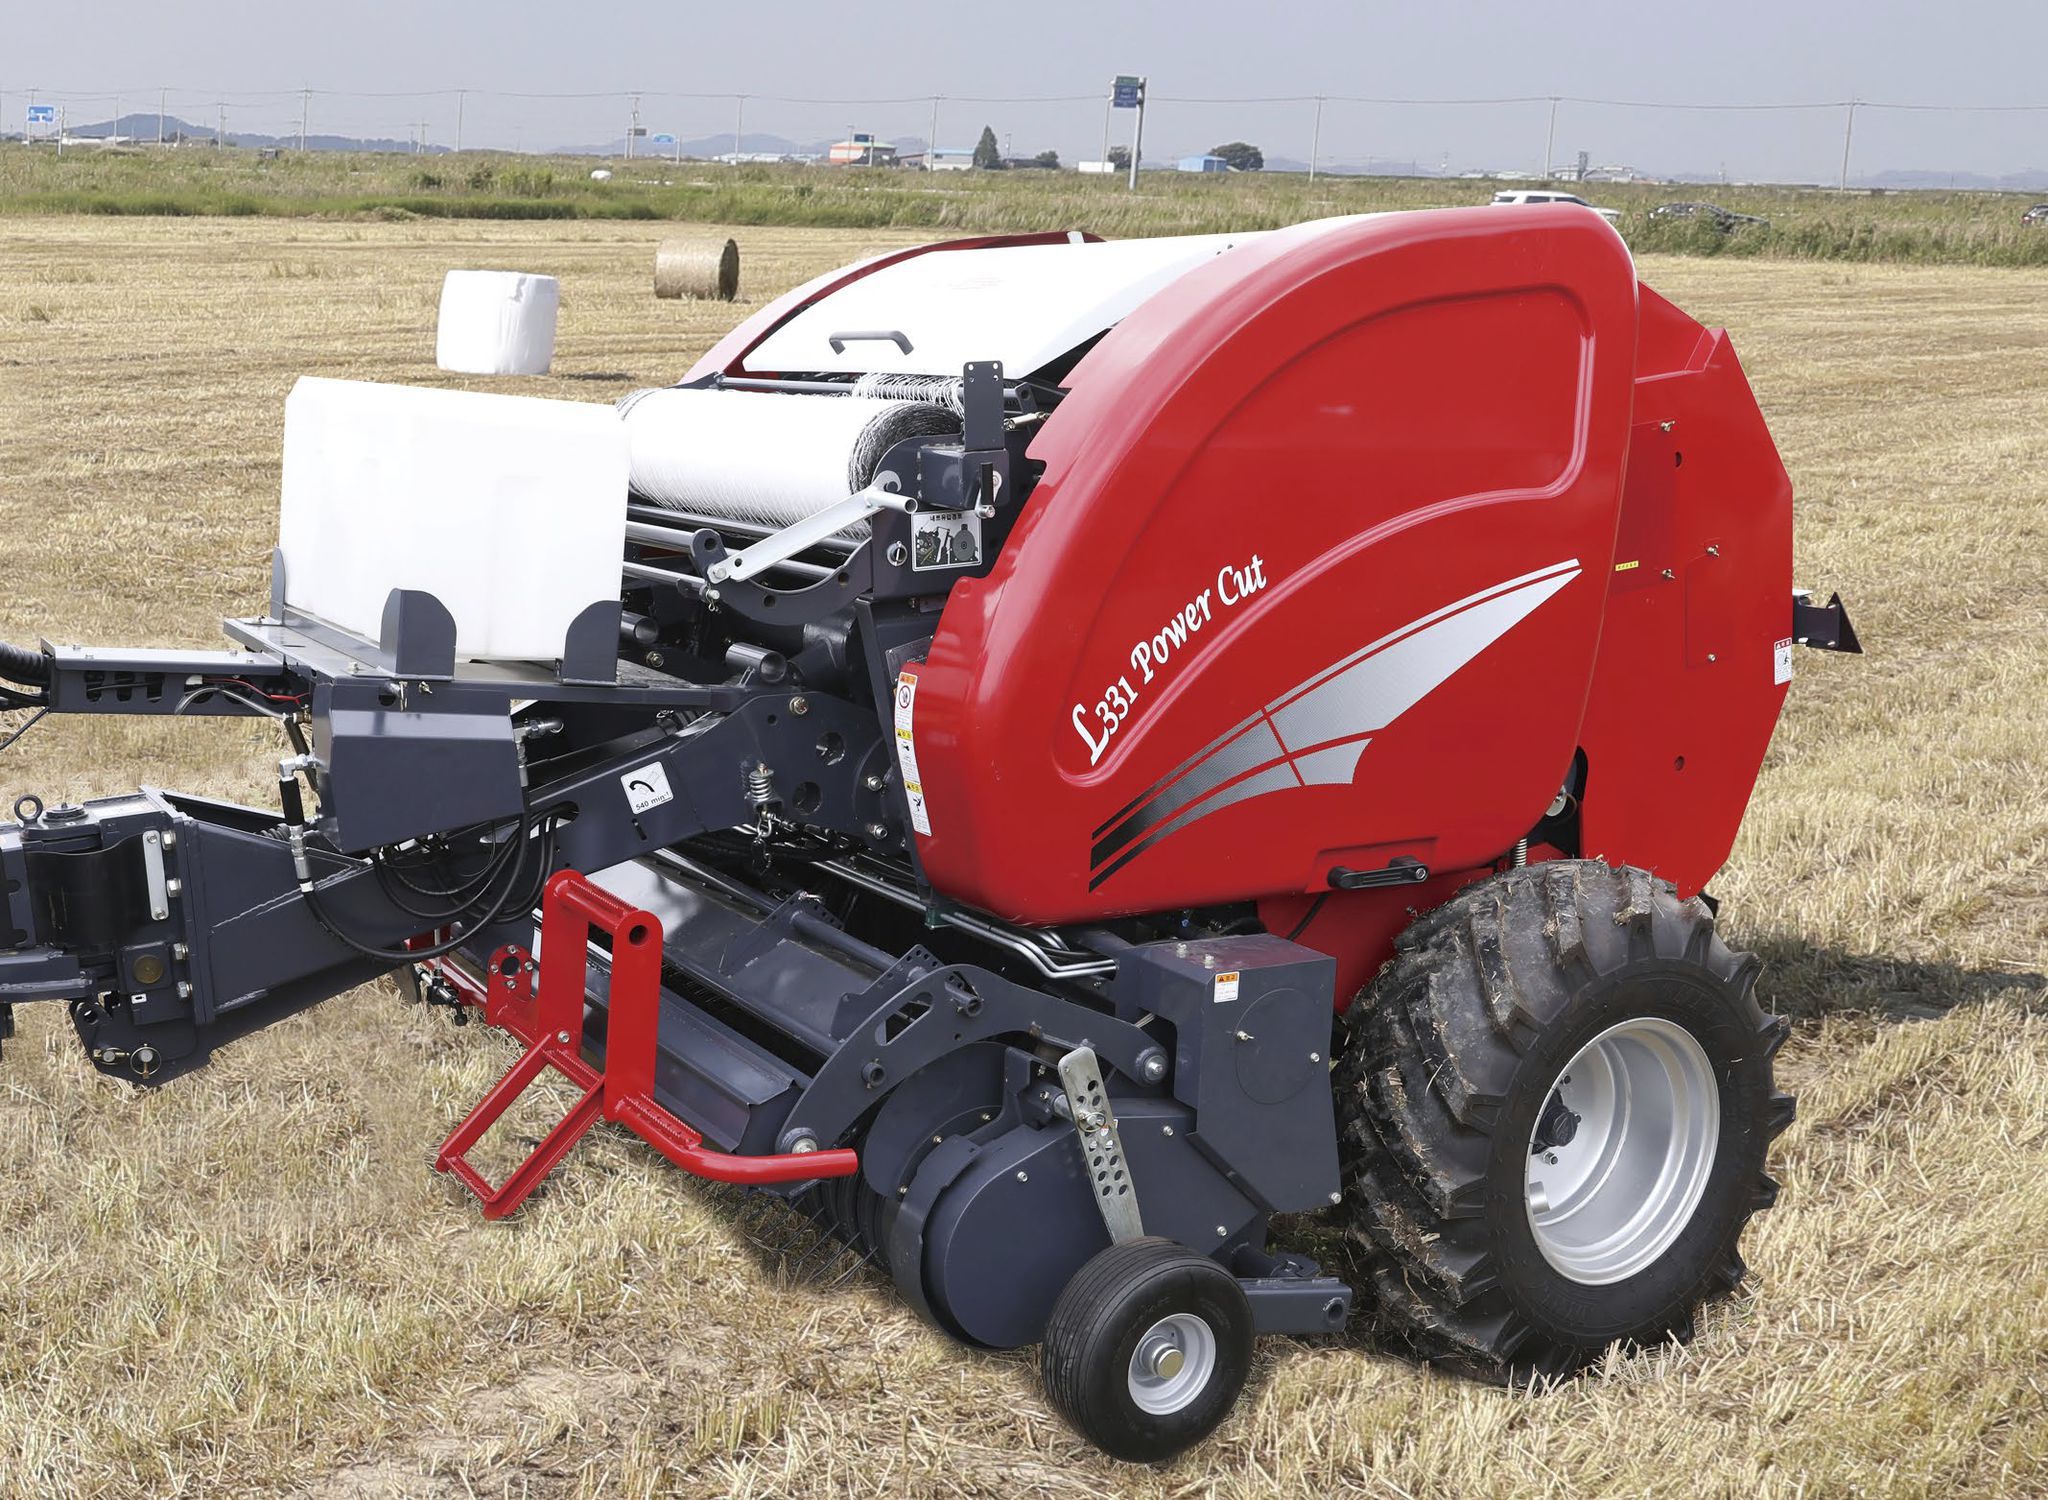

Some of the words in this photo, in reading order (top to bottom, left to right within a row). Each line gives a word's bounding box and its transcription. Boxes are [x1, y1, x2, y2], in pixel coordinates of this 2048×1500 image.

[1071, 676, 1140, 766] L331
[1130, 588, 1212, 685] Power
[1217, 554, 1267, 606] Cut
[636, 801, 649, 810] 540
